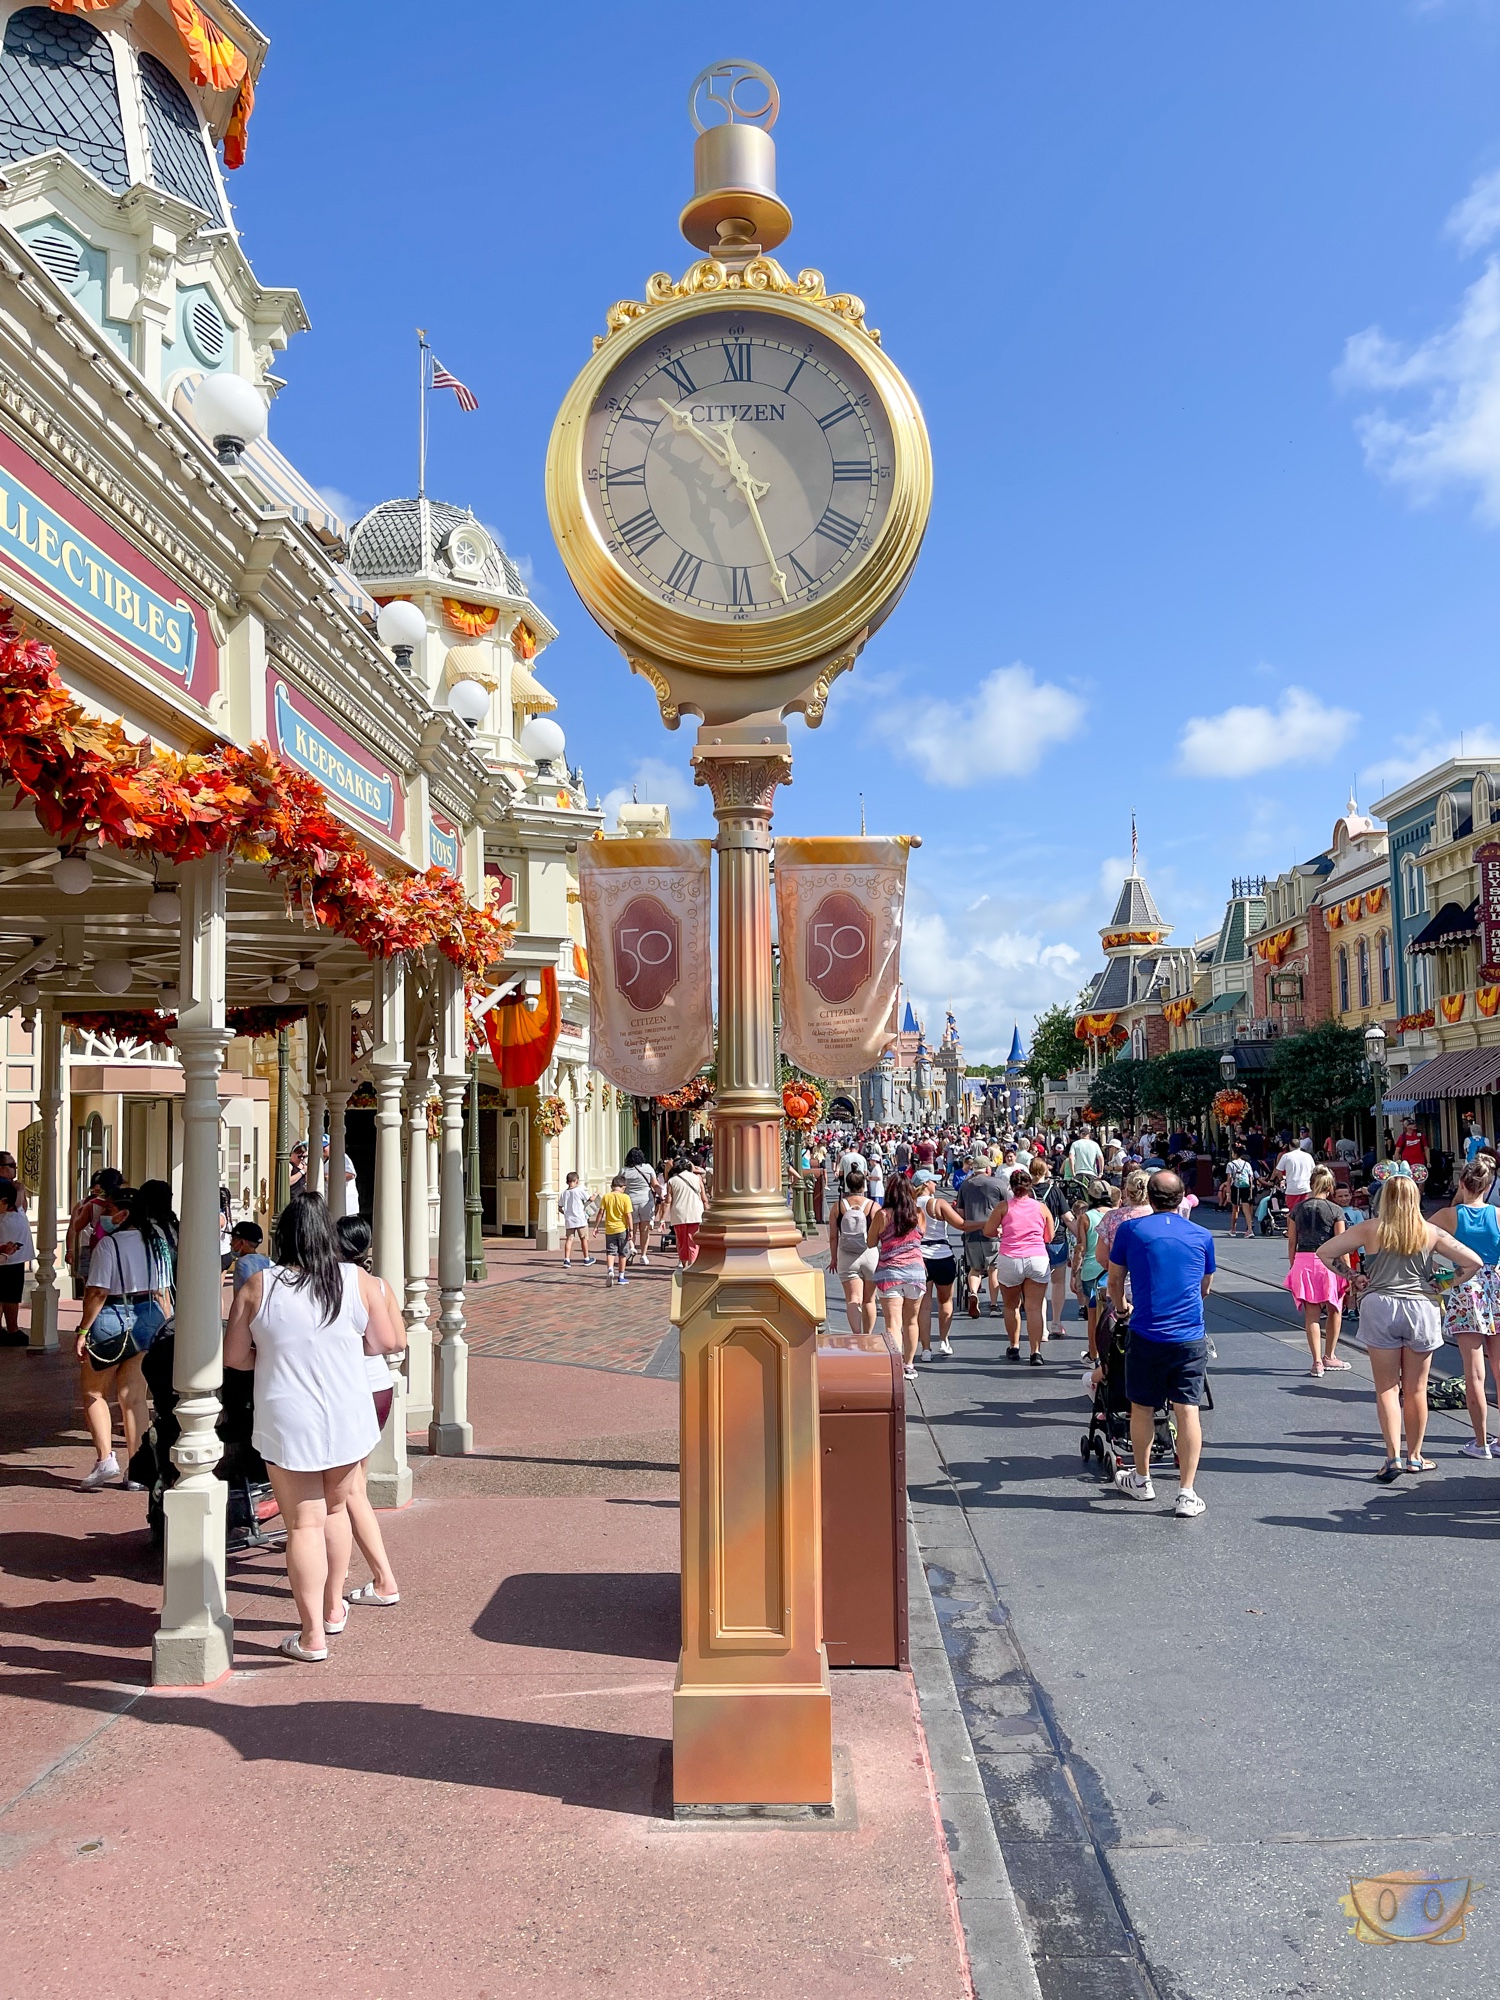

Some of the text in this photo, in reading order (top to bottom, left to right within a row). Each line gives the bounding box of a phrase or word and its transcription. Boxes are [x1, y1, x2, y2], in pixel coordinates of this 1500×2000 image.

[728, 325, 745, 336] 60
[656, 344, 672, 359] 55
[804, 343, 814, 353] 5
[722, 343, 752, 382] XII
[604, 397, 618, 413] 50
[857, 393, 872, 408] 10
[690, 403, 786, 422] CITIZEN
[588, 468, 598, 484] 45
[880, 465, 891, 479] 15
[860, 535, 874, 552] 20
[294, 723, 382, 811] KEEPSAKES
[431, 832, 454, 867] TOYS
[620, 928, 672, 987] 50
[814, 923, 866, 979] 50
[630, 1015, 667, 1027] CITIZEN
